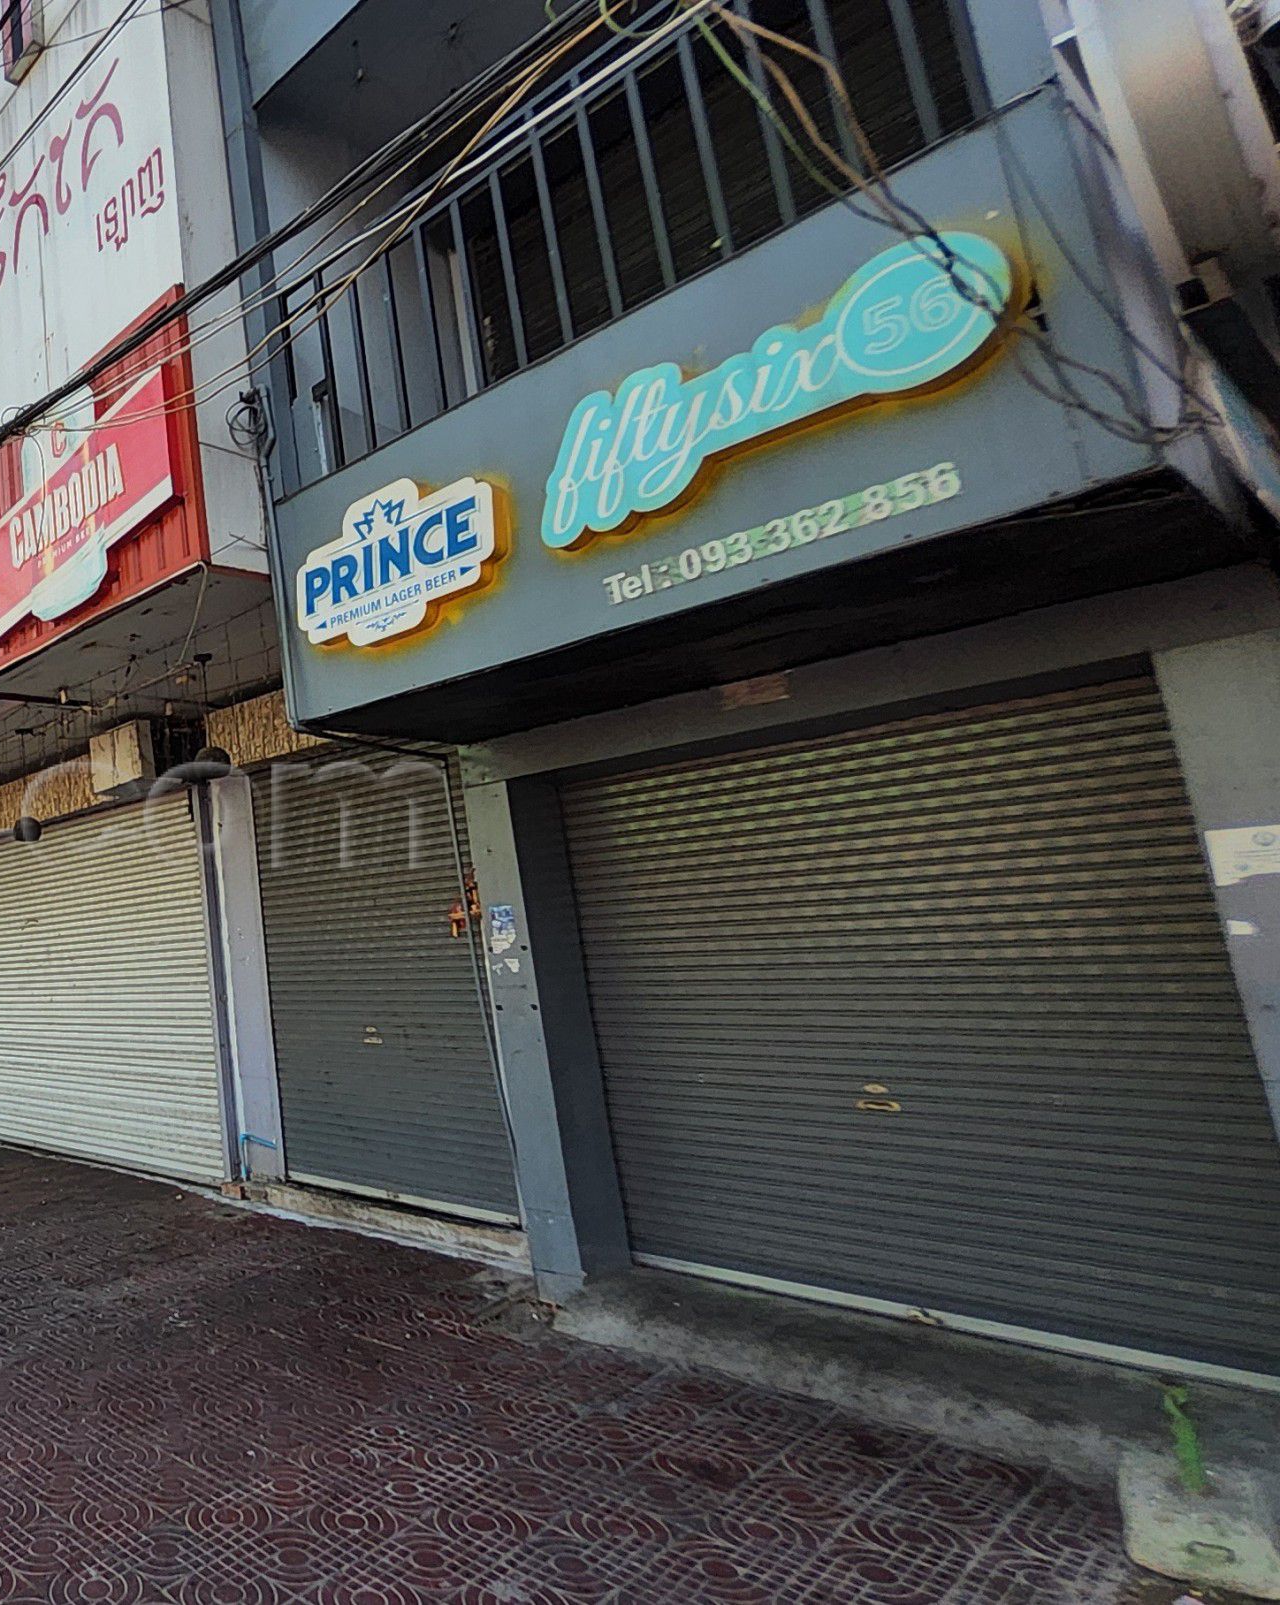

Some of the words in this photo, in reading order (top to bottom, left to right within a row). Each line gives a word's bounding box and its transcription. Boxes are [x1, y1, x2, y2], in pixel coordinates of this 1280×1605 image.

[862, 274, 961, 356] 56
[552, 334, 839, 535] fiftysix
[9, 443, 125, 569] CAMBODIA
[305, 496, 478, 616] PRINCE
[678, 532, 753, 581] 093
[860, 461, 962, 522] 856
[330, 601, 382, 628] PREMIUM
[384, 584, 421, 607] LAGER
[425, 569, 457, 592] BEER
